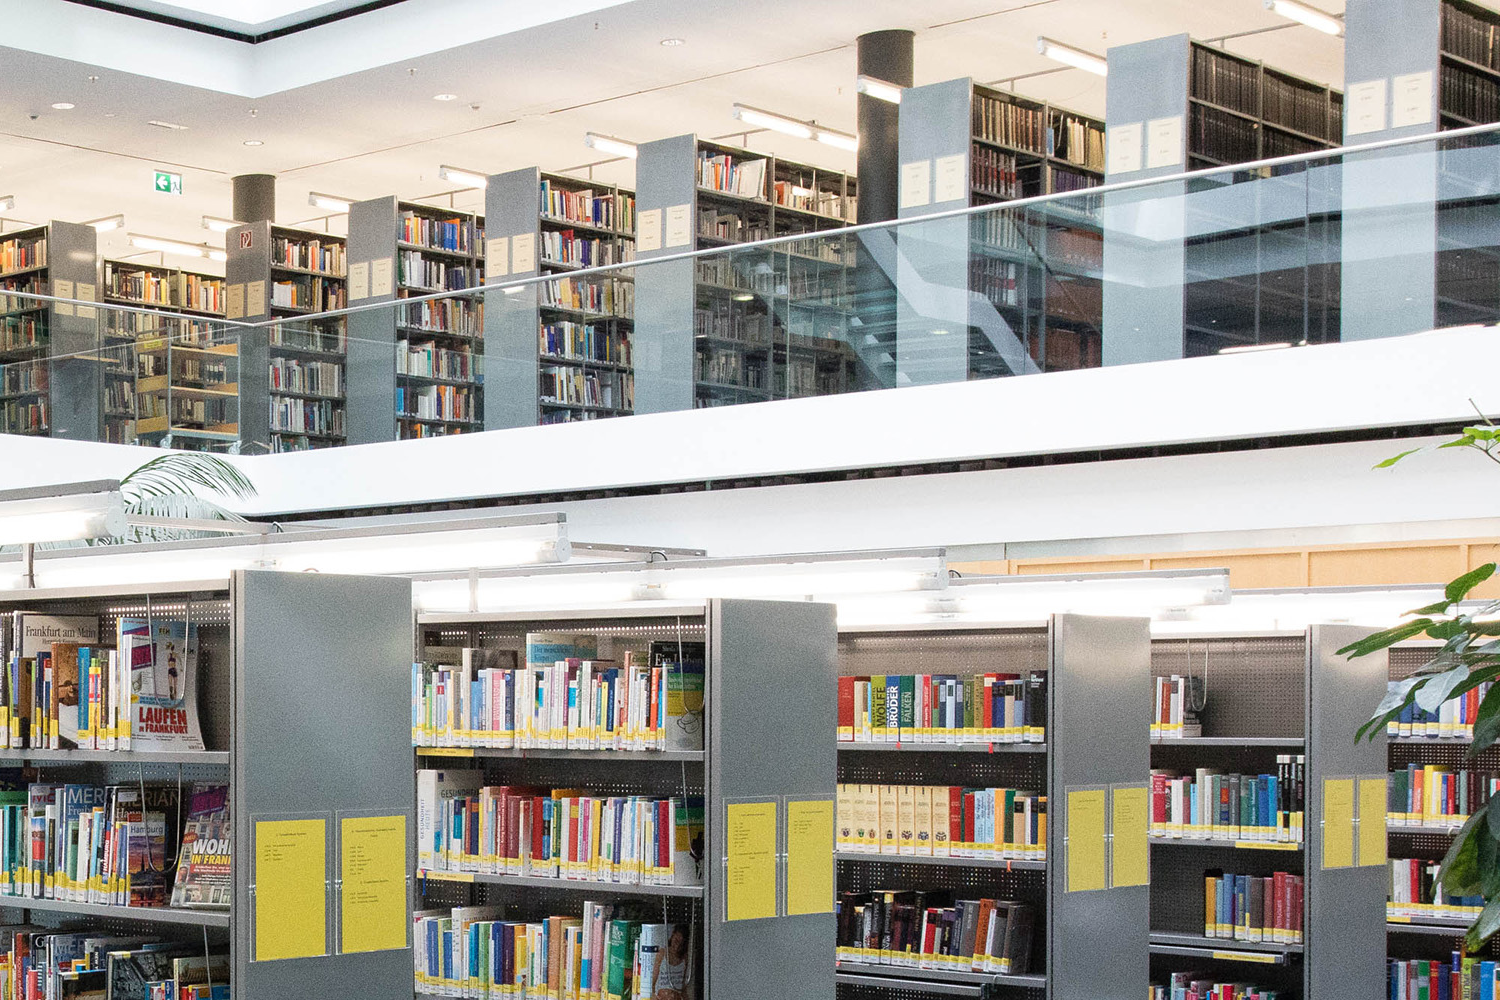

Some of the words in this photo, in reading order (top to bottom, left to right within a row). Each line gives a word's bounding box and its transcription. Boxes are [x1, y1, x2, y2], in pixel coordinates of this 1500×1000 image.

[26, 625, 60, 637] Frankfurt
[63, 629, 75, 637] am
[77, 627, 97, 638] Main
[889, 686, 899, 728] BRÜDER
[904, 691, 912, 723] FALKEN
[139, 706, 188, 725] LAUFEN
[145, 724, 188, 734] FRANKFURT
[130, 825, 163, 834] Hamburg
[102, 839, 110, 873] HAMBURG
[191, 855, 201, 865] IN
